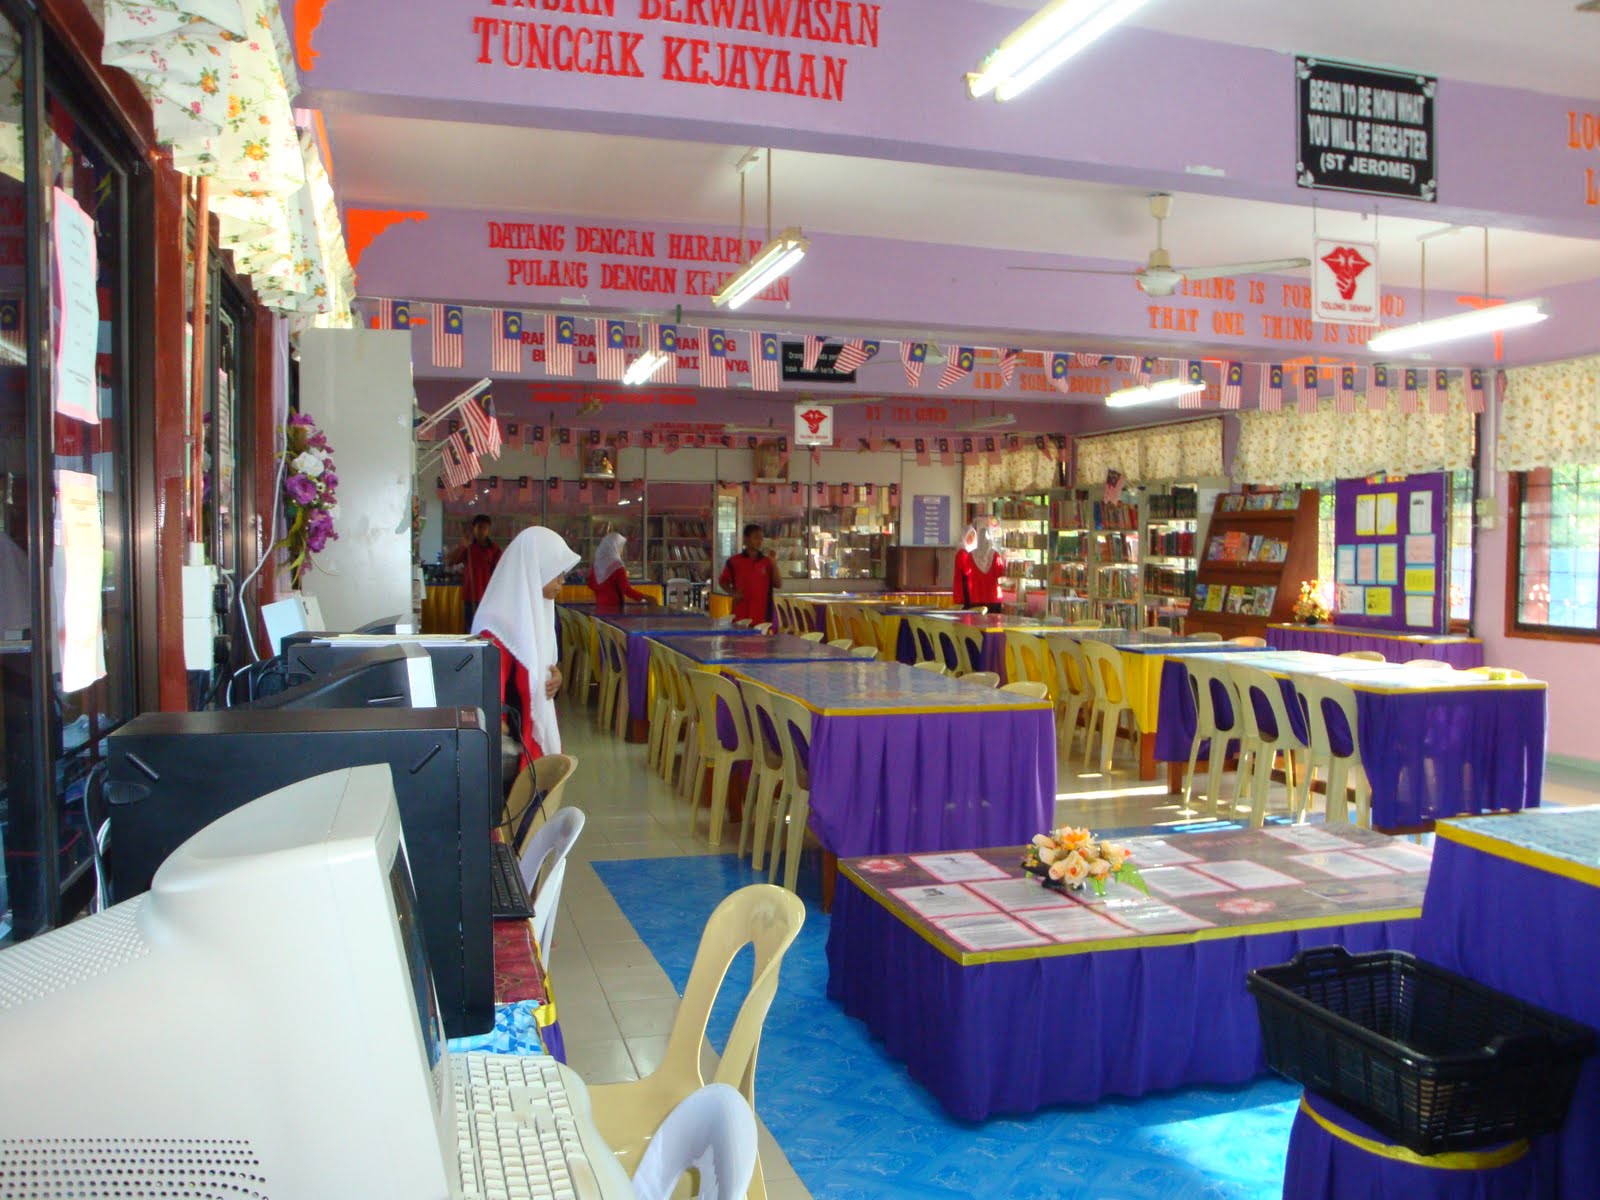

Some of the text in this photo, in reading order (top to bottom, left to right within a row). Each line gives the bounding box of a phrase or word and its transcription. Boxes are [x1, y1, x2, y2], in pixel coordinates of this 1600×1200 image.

[662, 35, 848, 102] KEJAYAAN
[1309, 78, 1425, 126] BEGIN TO BE NOW WHAT
[1307, 114, 1427, 161] YOU WILL BE HEREAFTER
[1320, 152, 1416, 185] (ST JEROME)
[487, 221, 566, 253] DATANG
[507, 258, 588, 289] PULANG
[600, 263, 677, 295] DENGAN
[1147, 304, 1200, 333] THAT
[1212, 311, 1246, 337] ONE
[1261, 313, 1313, 342] THING
